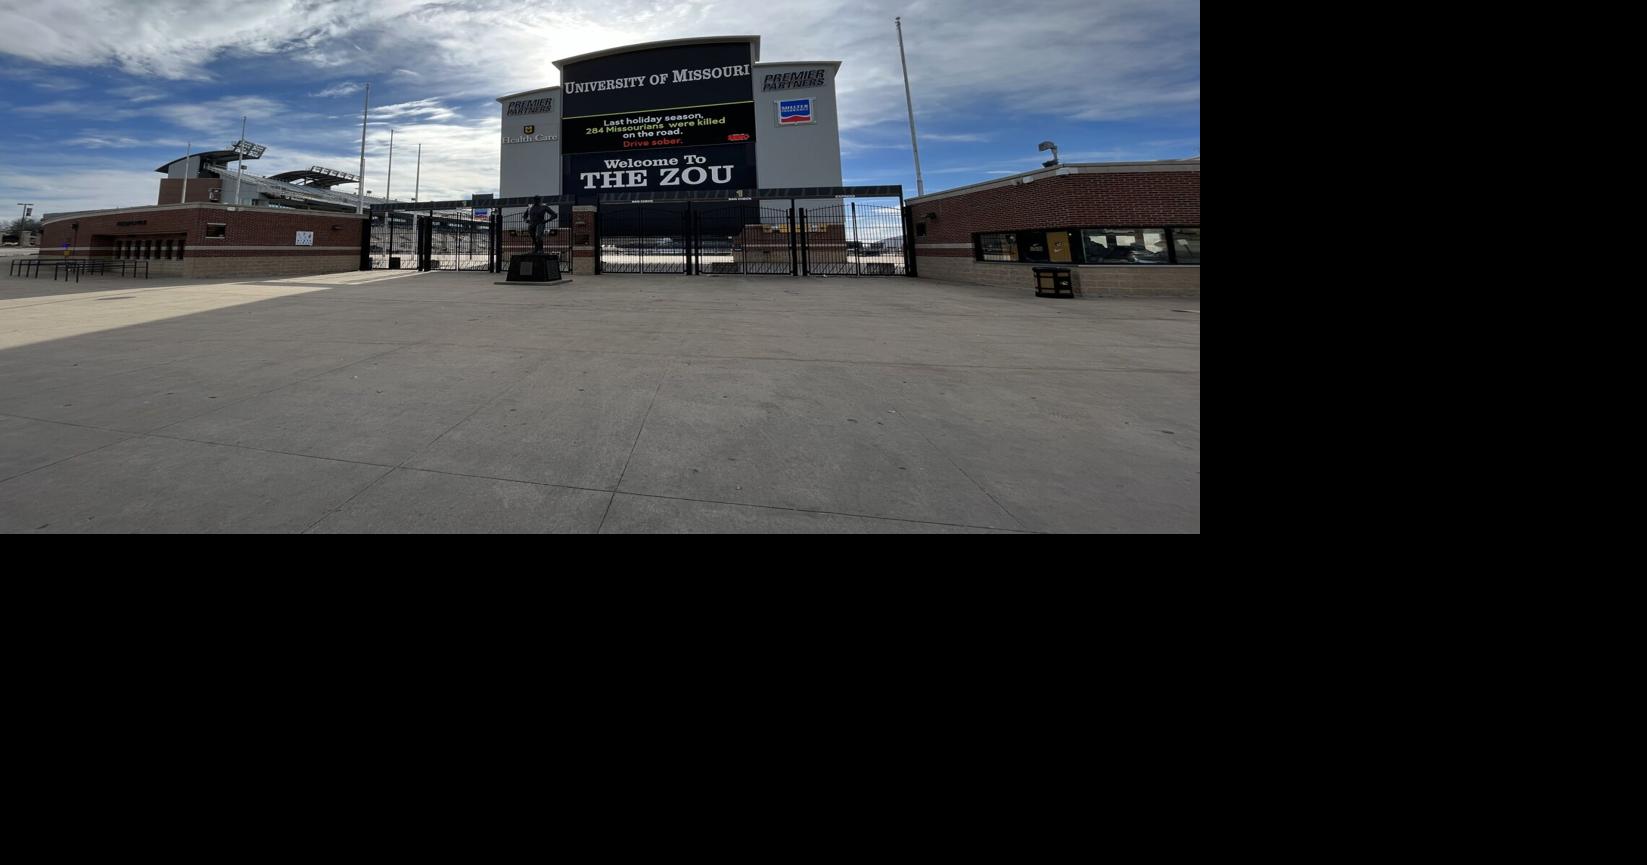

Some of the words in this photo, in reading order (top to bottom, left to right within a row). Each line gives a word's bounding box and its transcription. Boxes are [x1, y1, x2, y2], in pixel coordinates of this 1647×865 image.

[564, 76, 646, 94] UNIVERSITY
[649, 73, 669, 86] OF
[672, 64, 750, 83] MISSOURI
[763, 69, 825, 84] PREMIER
[762, 78, 825, 92] PARTNERS
[585, 127, 604, 135] 284
[605, 123, 664, 133] Missourians
[668, 120, 695, 128] were
[697, 116, 726, 127] killed
[603, 119, 625, 127] Last
[626, 116, 663, 124] holiday
[664, 113, 704, 122] season,
[502, 135, 533, 143] Health
[534, 133, 558, 142] Care
[637, 130, 654, 138] the
[656, 128, 683, 137] road.
[623, 140, 650, 148] Drive
[651, 138, 683, 146] sober.
[604, 157, 679, 169] Welcome
[683, 154, 707, 165] To
[580, 169, 648, 189] THE
[659, 165, 735, 186] ZOU
